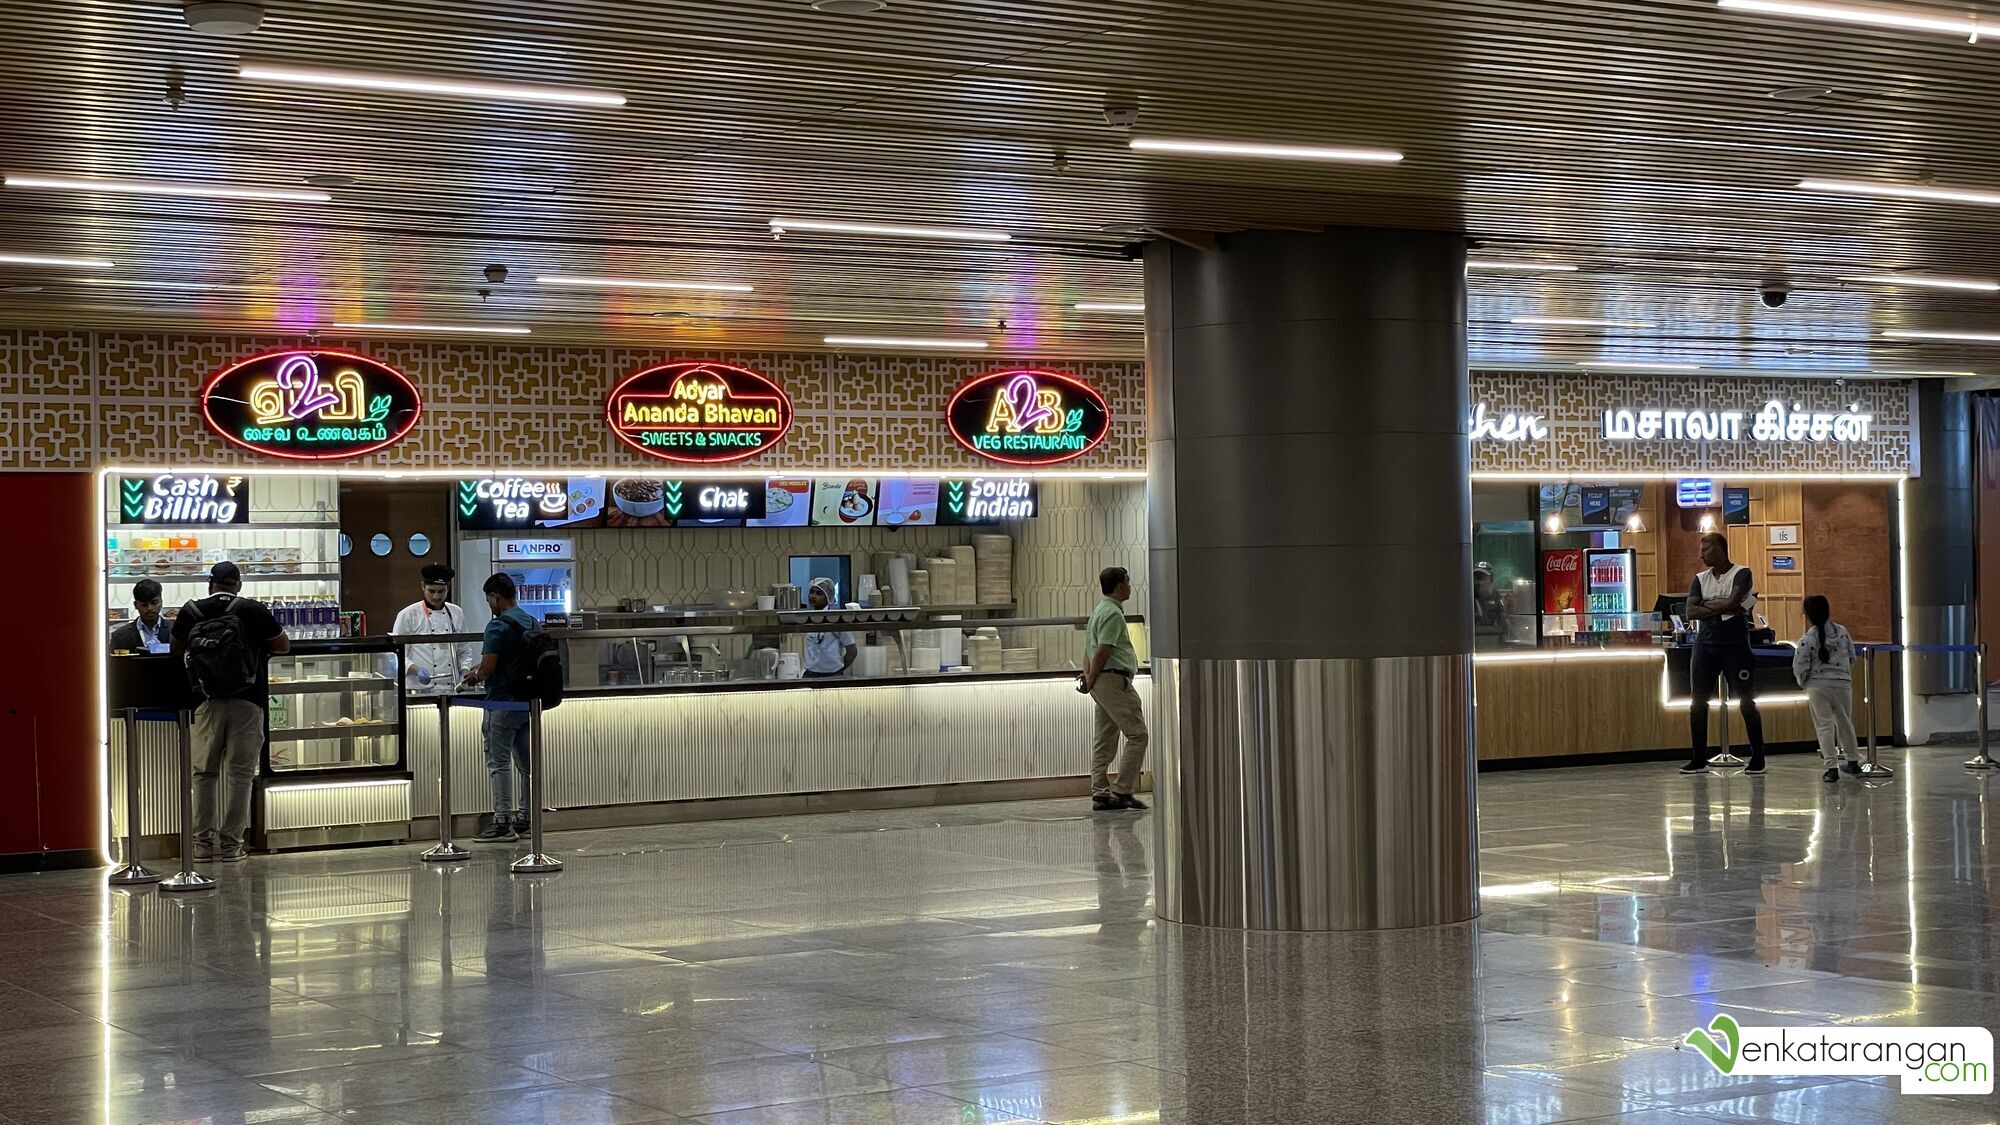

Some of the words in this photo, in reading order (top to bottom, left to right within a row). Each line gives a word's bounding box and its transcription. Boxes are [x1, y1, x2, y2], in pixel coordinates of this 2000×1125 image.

[673, 379, 726, 405] Adyar
[623, 402, 700, 423] Ananda
[704, 403, 778, 424] Bhavan
[985, 374, 1066, 434] A2B
[1601, 408, 1743, 440] மசாலா
[1750, 400, 1872, 442] கிச்சன்
[243, 427, 291, 442] சைவ
[296, 423, 388, 442] உணவகம்
[641, 432, 693, 446] SWEETS
[695, 432, 707, 446] &
[709, 432, 762, 446] SNACKS
[972, 435, 1002, 450] VEG
[1003, 435, 1087, 450] RESTAURANT
[152, 473, 219, 497] Cash
[476, 477, 546, 499] Coffee
[969, 478, 1030, 498] South
[699, 486, 749, 508] Chat
[966, 496, 1034, 518] Indian
[144, 496, 238, 524] Billing
[492, 498, 530, 519] Tea
[507, 543, 561, 555] ELANPRO
